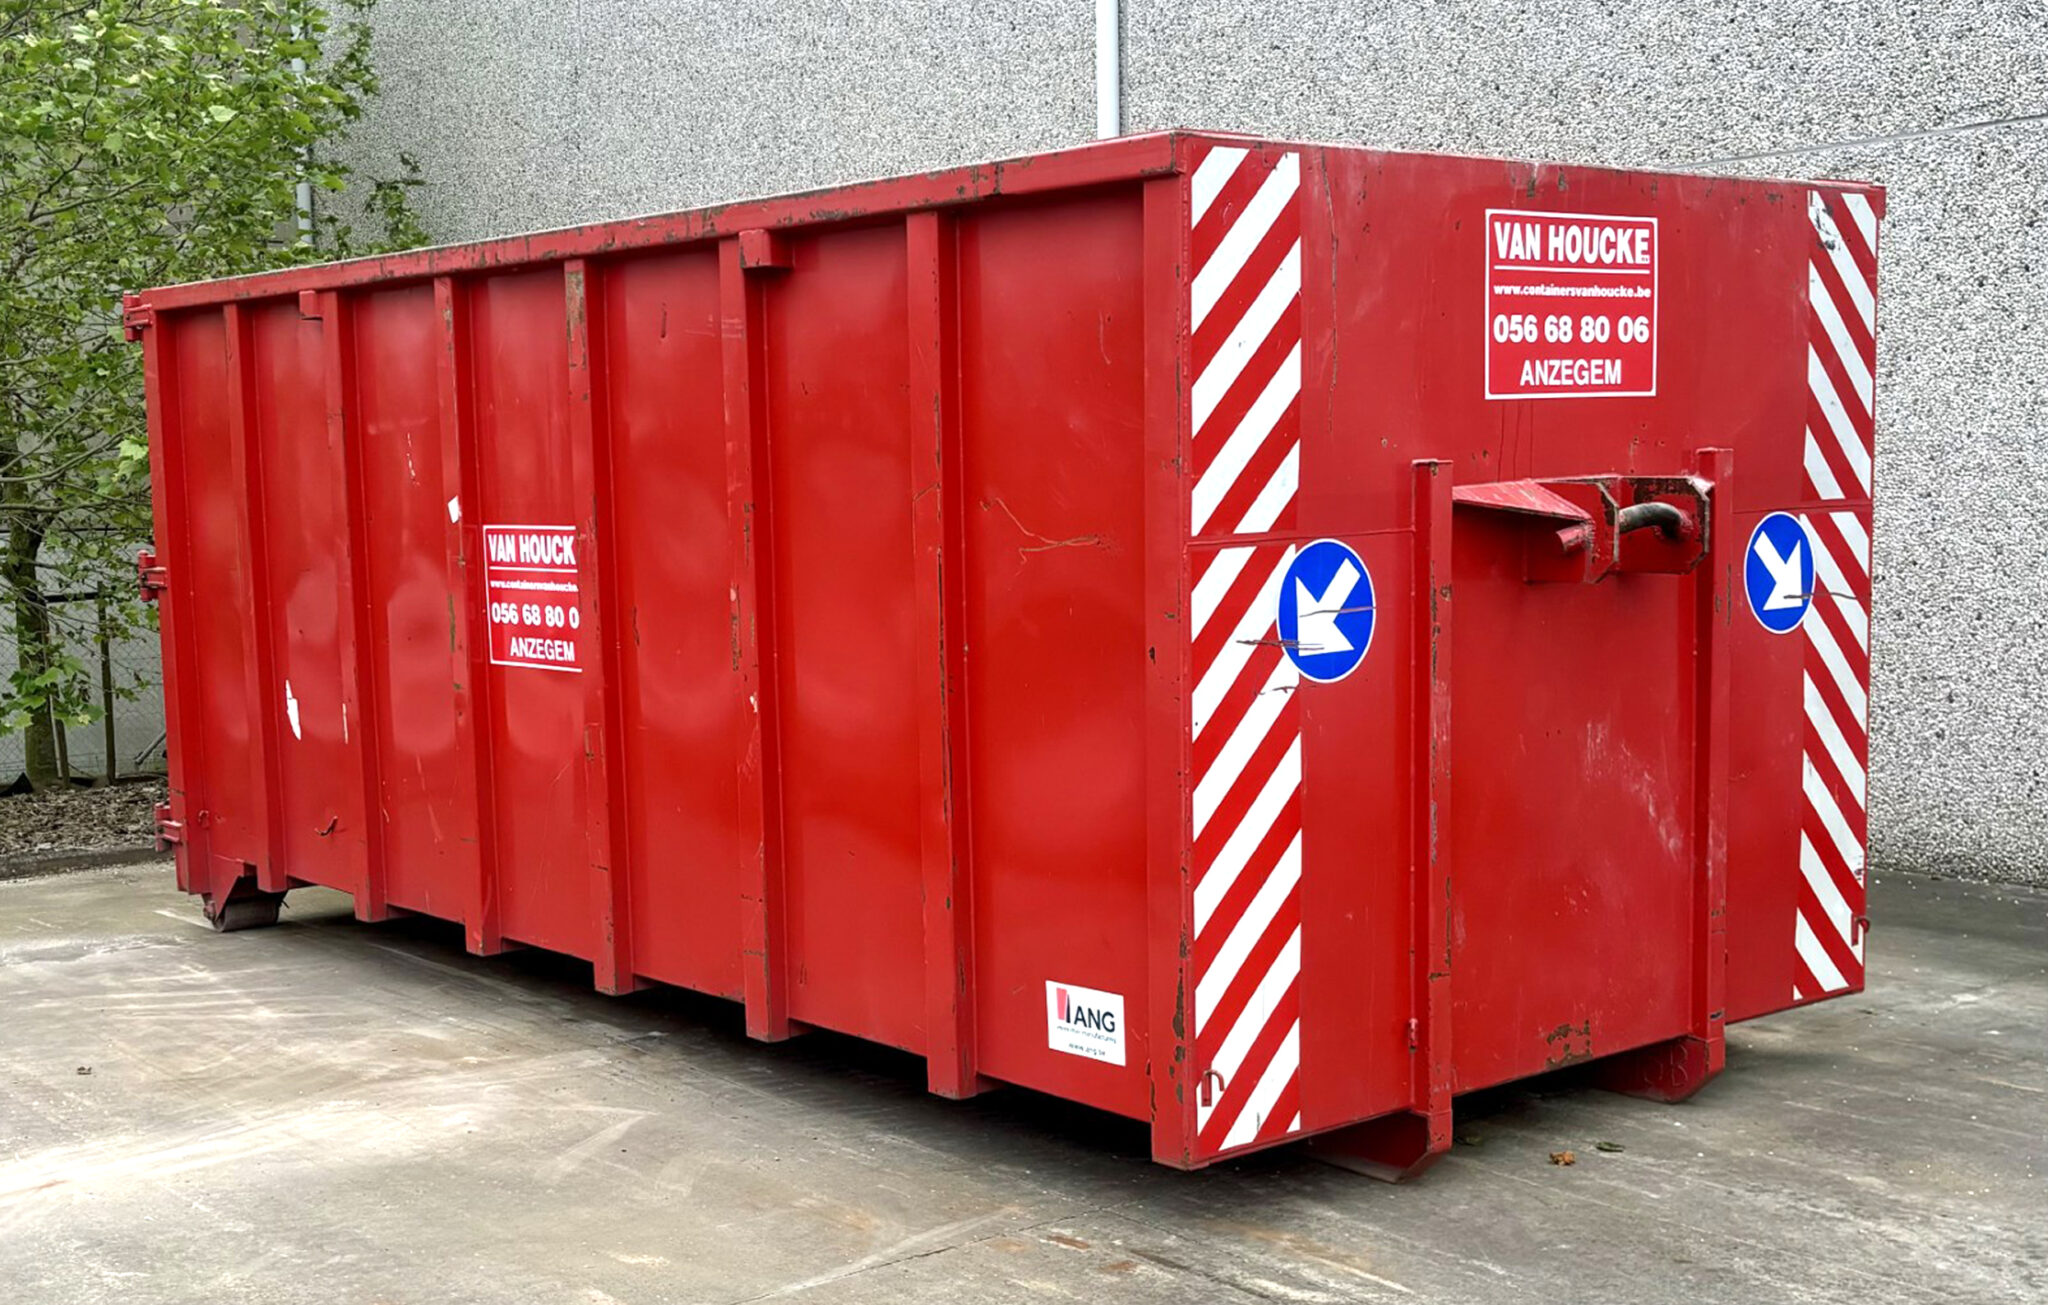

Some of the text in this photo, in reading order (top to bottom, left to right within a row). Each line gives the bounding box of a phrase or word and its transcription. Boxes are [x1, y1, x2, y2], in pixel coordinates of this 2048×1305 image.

[1494, 221, 1651, 265] VAN HOUCKE
[1493, 283, 1651, 298] www.containersvanhoucke.be
[1493, 315, 1650, 343] 056 68 80 06
[1519, 359, 1622, 386] ANZEGEM
[488, 534, 577, 565] VAN HOUCK
[491, 602, 580, 629] 056 68 80 0
[510, 637, 576, 662] ANZEGEM
